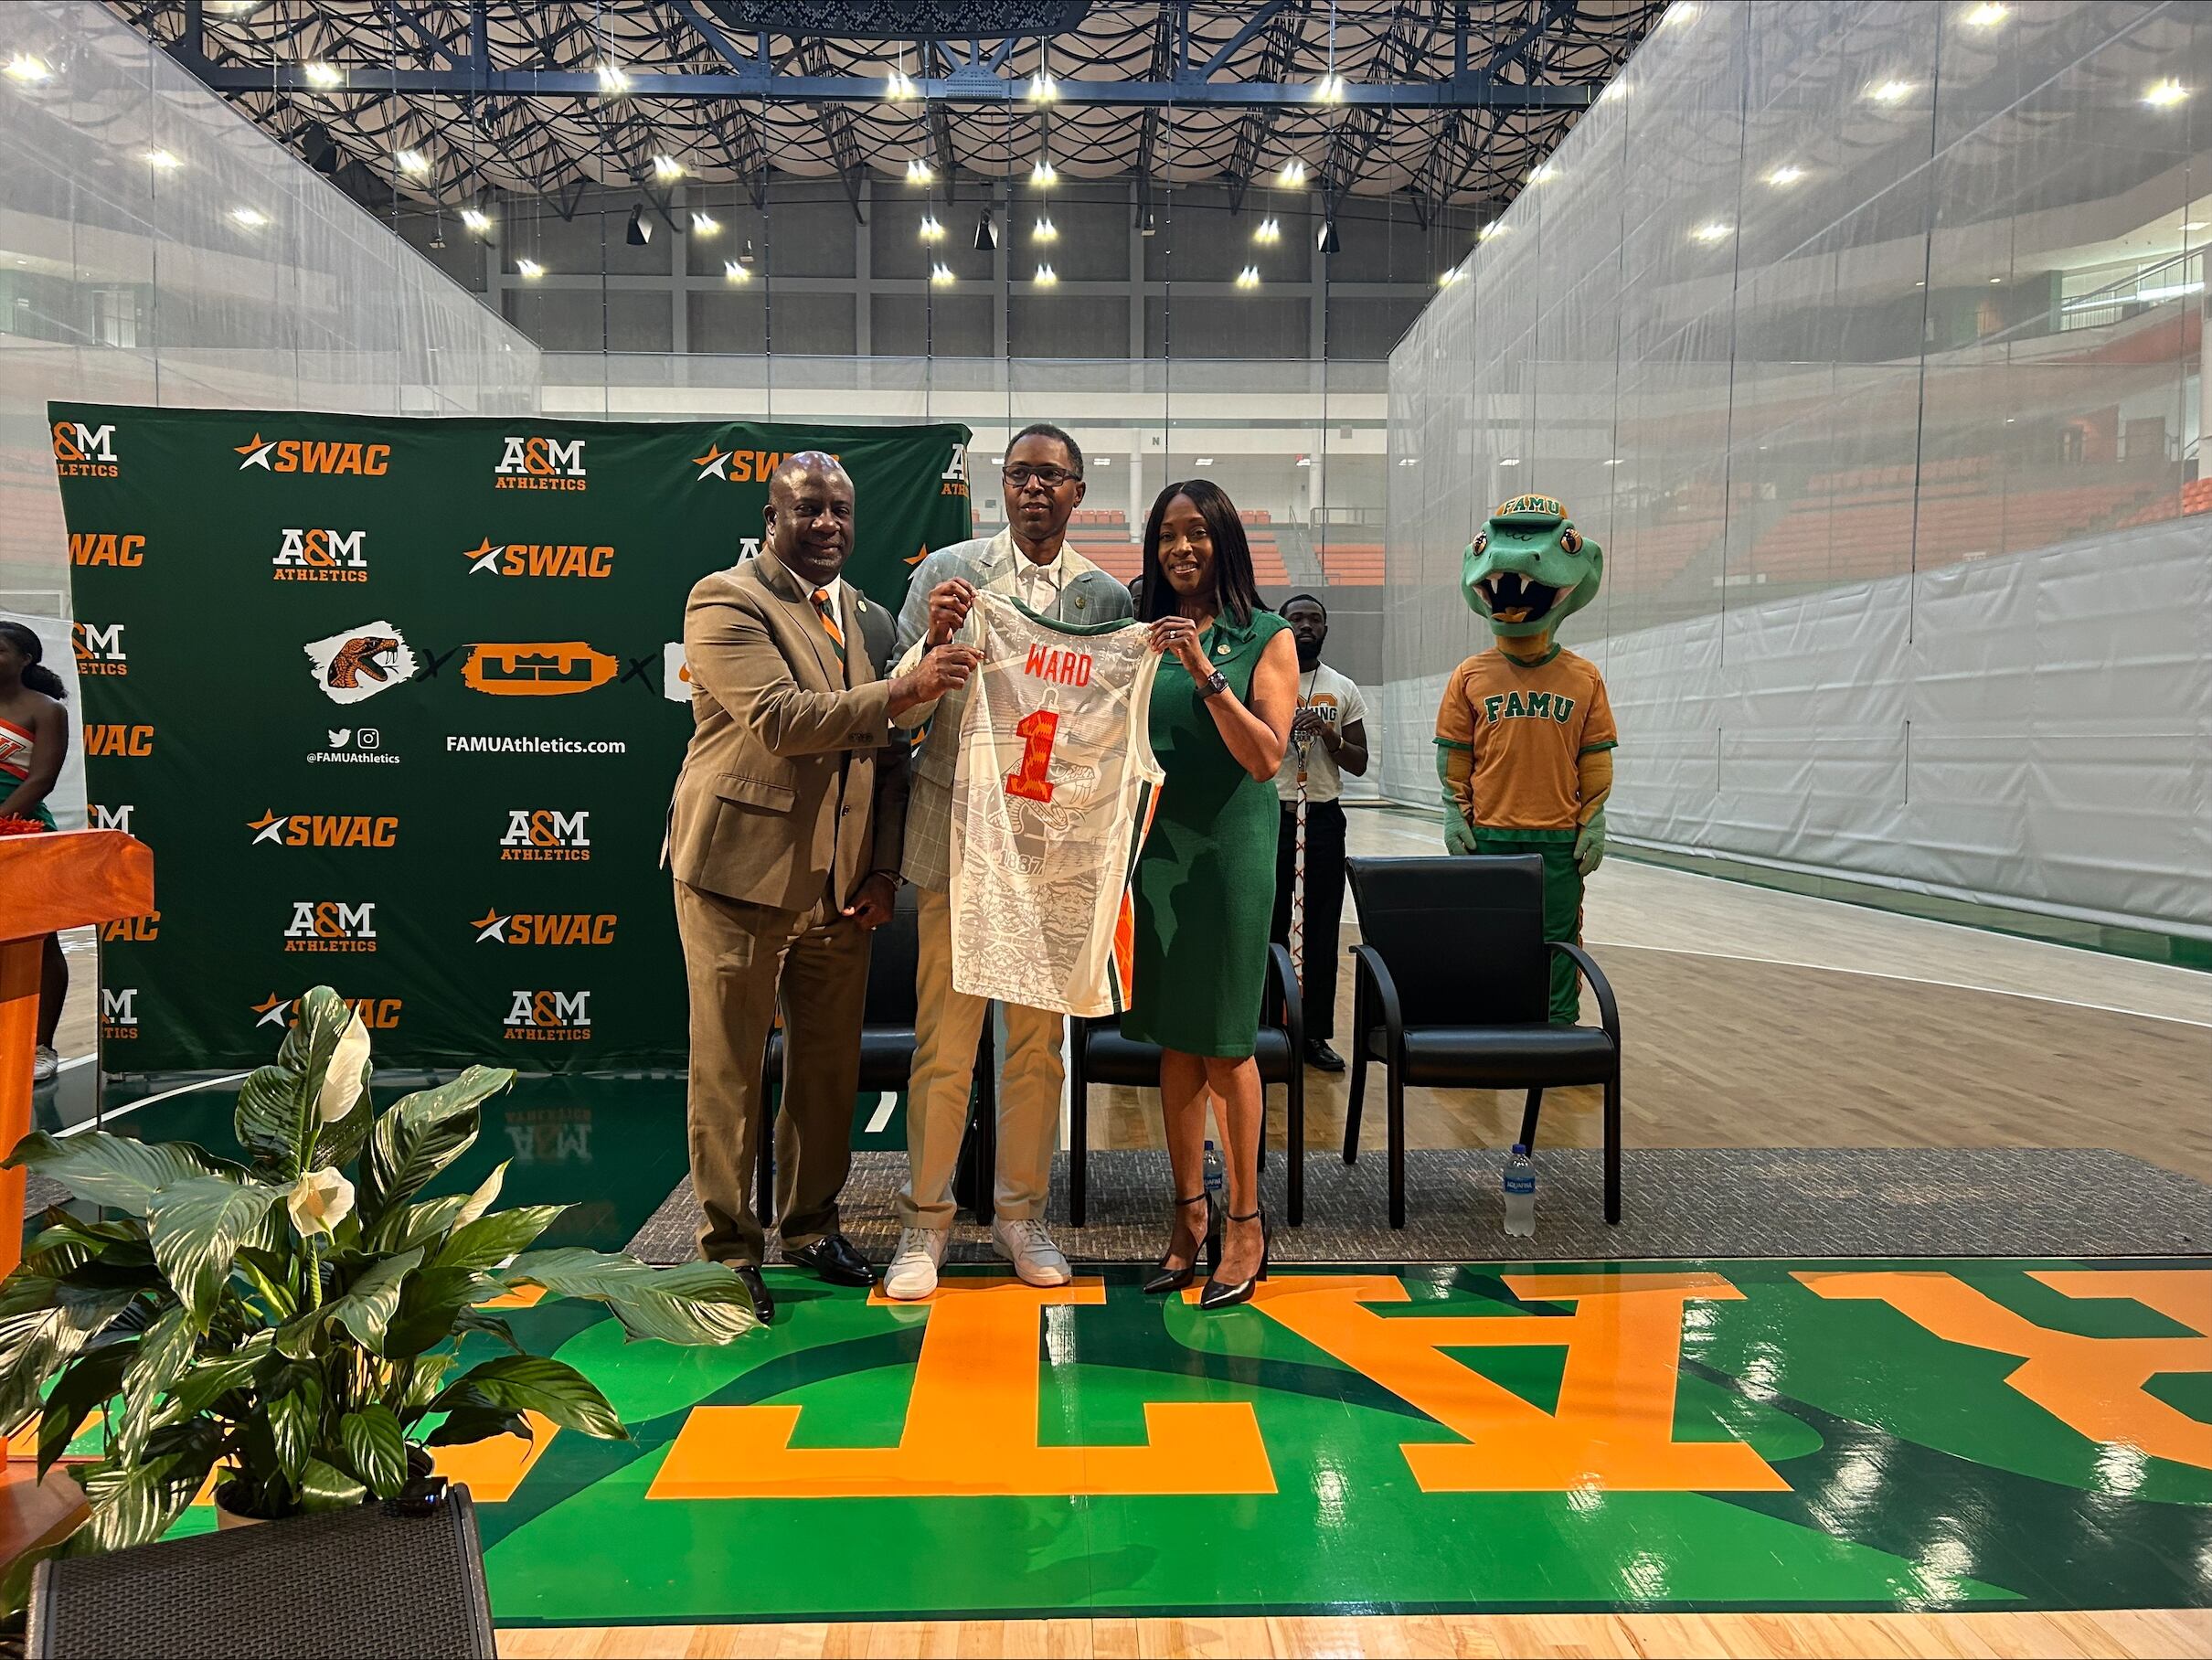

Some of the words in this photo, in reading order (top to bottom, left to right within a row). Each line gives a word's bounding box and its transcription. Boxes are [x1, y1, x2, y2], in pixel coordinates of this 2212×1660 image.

[53, 421, 117, 461] &M
[495, 437, 586, 476] A&M
[273, 440, 390, 476] SWAC
[495, 477, 586, 491] ATHLETICS
[1503, 496, 1560, 516] FAMU
[272, 528, 367, 568] A&M
[502, 545, 615, 578] SWAC
[273, 569, 367, 582] ATHLETICS
[79, 663, 128, 676] ETICS
[1024, 643, 1093, 687] WARD
[1484, 691, 1575, 724] FAMU
[306, 751, 400, 764] @FAMUAthletics
[446, 735, 626, 753] FAMUAthletics.com
[1005, 709, 1060, 803] 1
[285, 814, 399, 847] SWAC
[499, 810, 590, 847] A&M
[500, 849, 590, 861] ATHLETICS
[998, 850, 1045, 876] 1887
[283, 901, 377, 938] A&M
[508, 914, 617, 945] SWAC
[284, 940, 377, 952] ATHLETICS
[504, 990, 591, 1027] A&M
[504, 1027, 591, 1040] ATHLETICS
